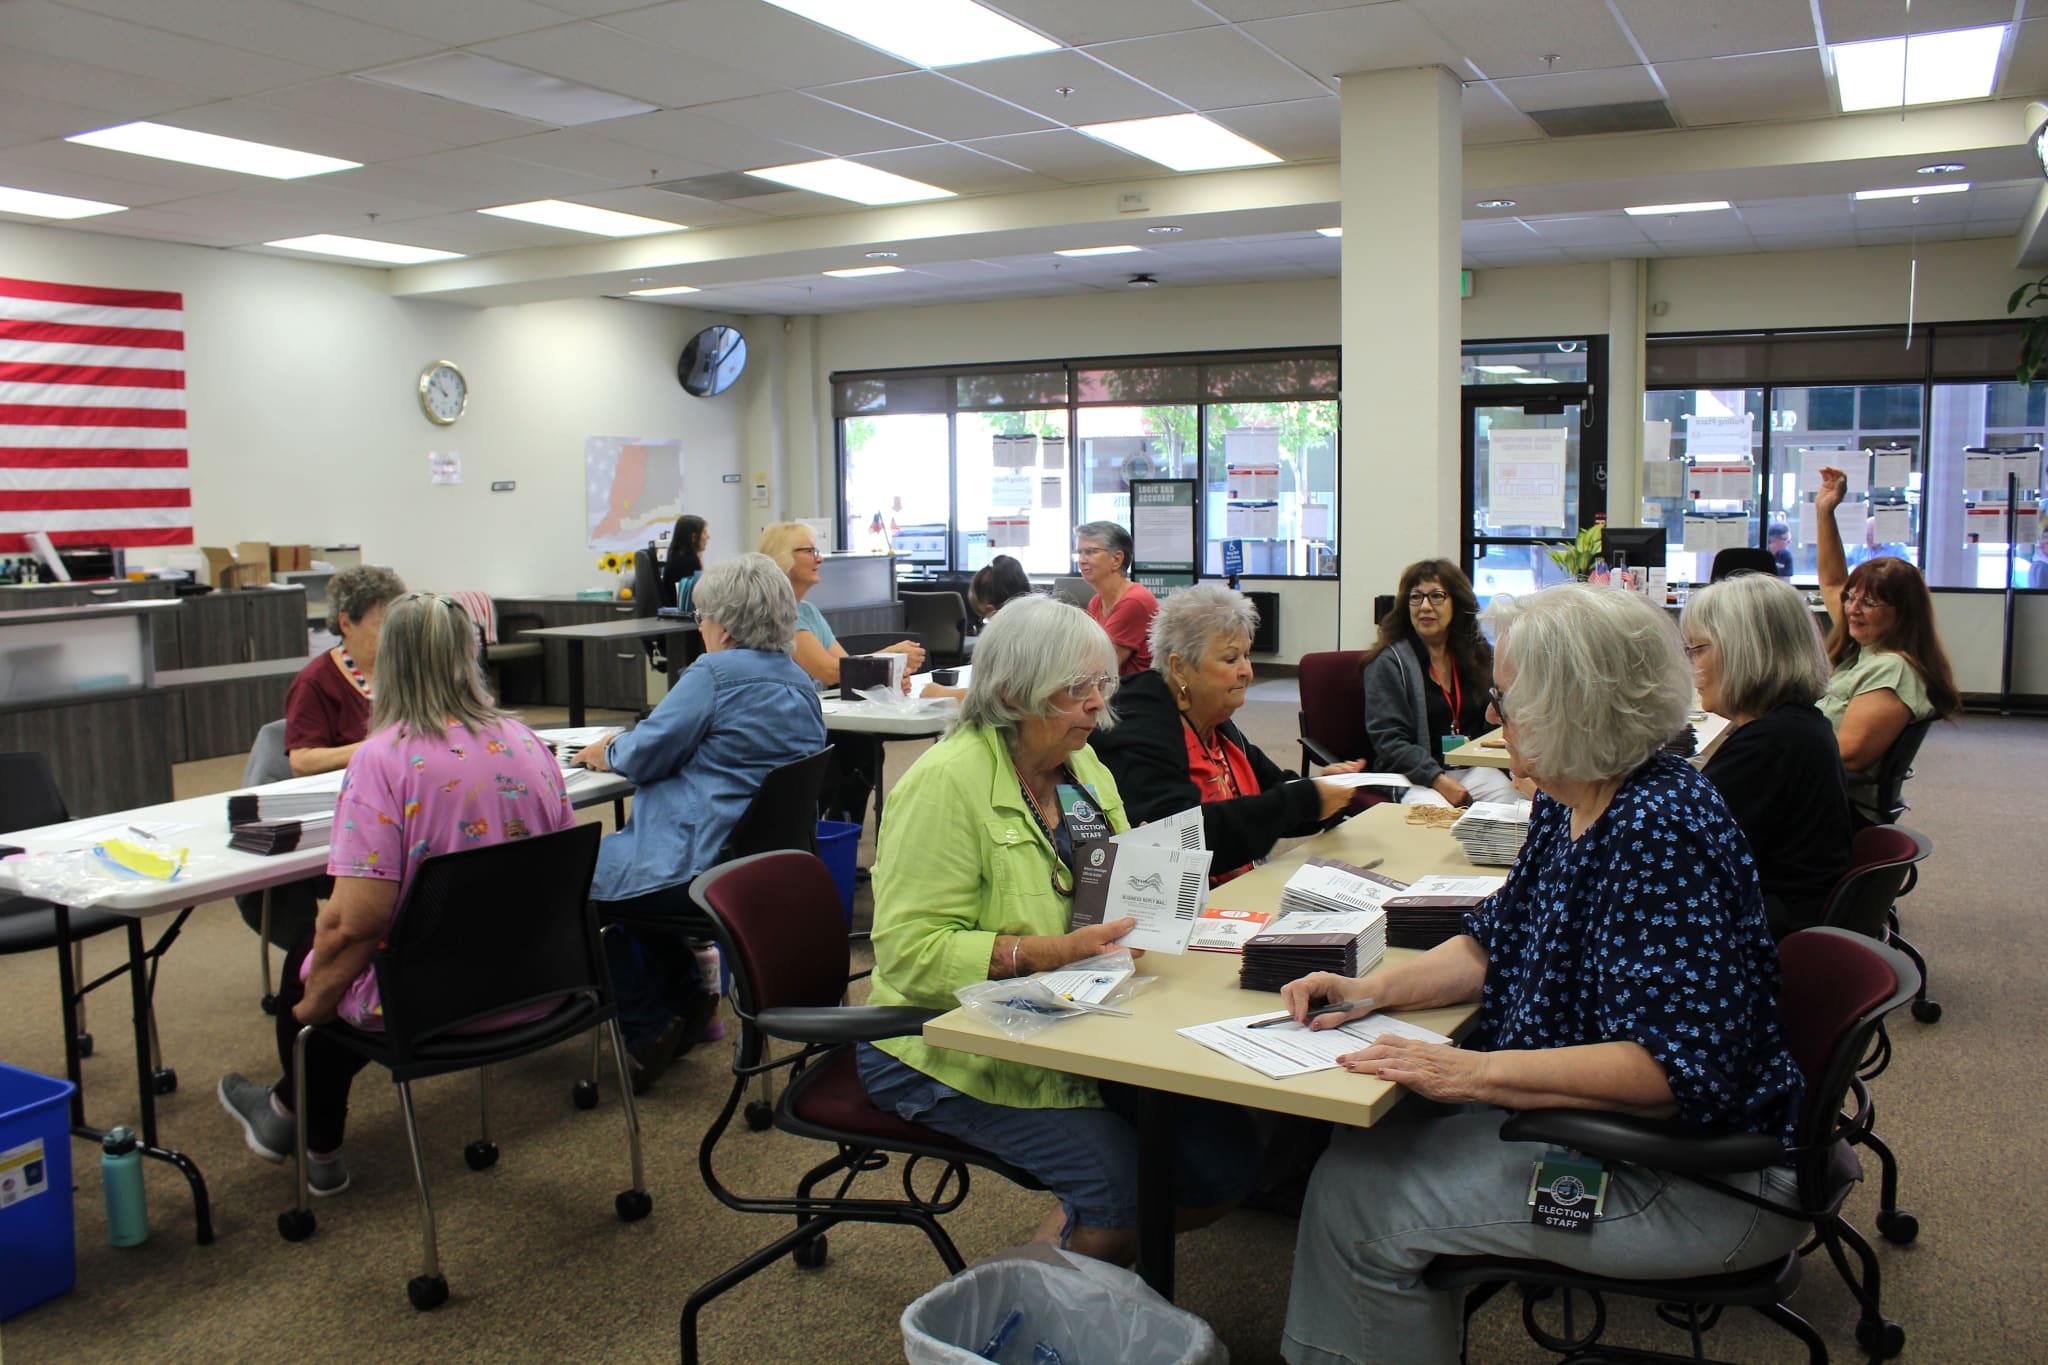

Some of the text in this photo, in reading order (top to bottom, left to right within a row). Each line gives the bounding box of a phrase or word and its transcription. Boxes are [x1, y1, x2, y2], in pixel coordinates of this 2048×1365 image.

[1138, 485, 1175, 494] LOGIC AND
[1138, 494, 1175, 503] ACCURACY
[1538, 1204, 1590, 1219] ELECTION
[1545, 1216, 1579, 1228] STAFF
